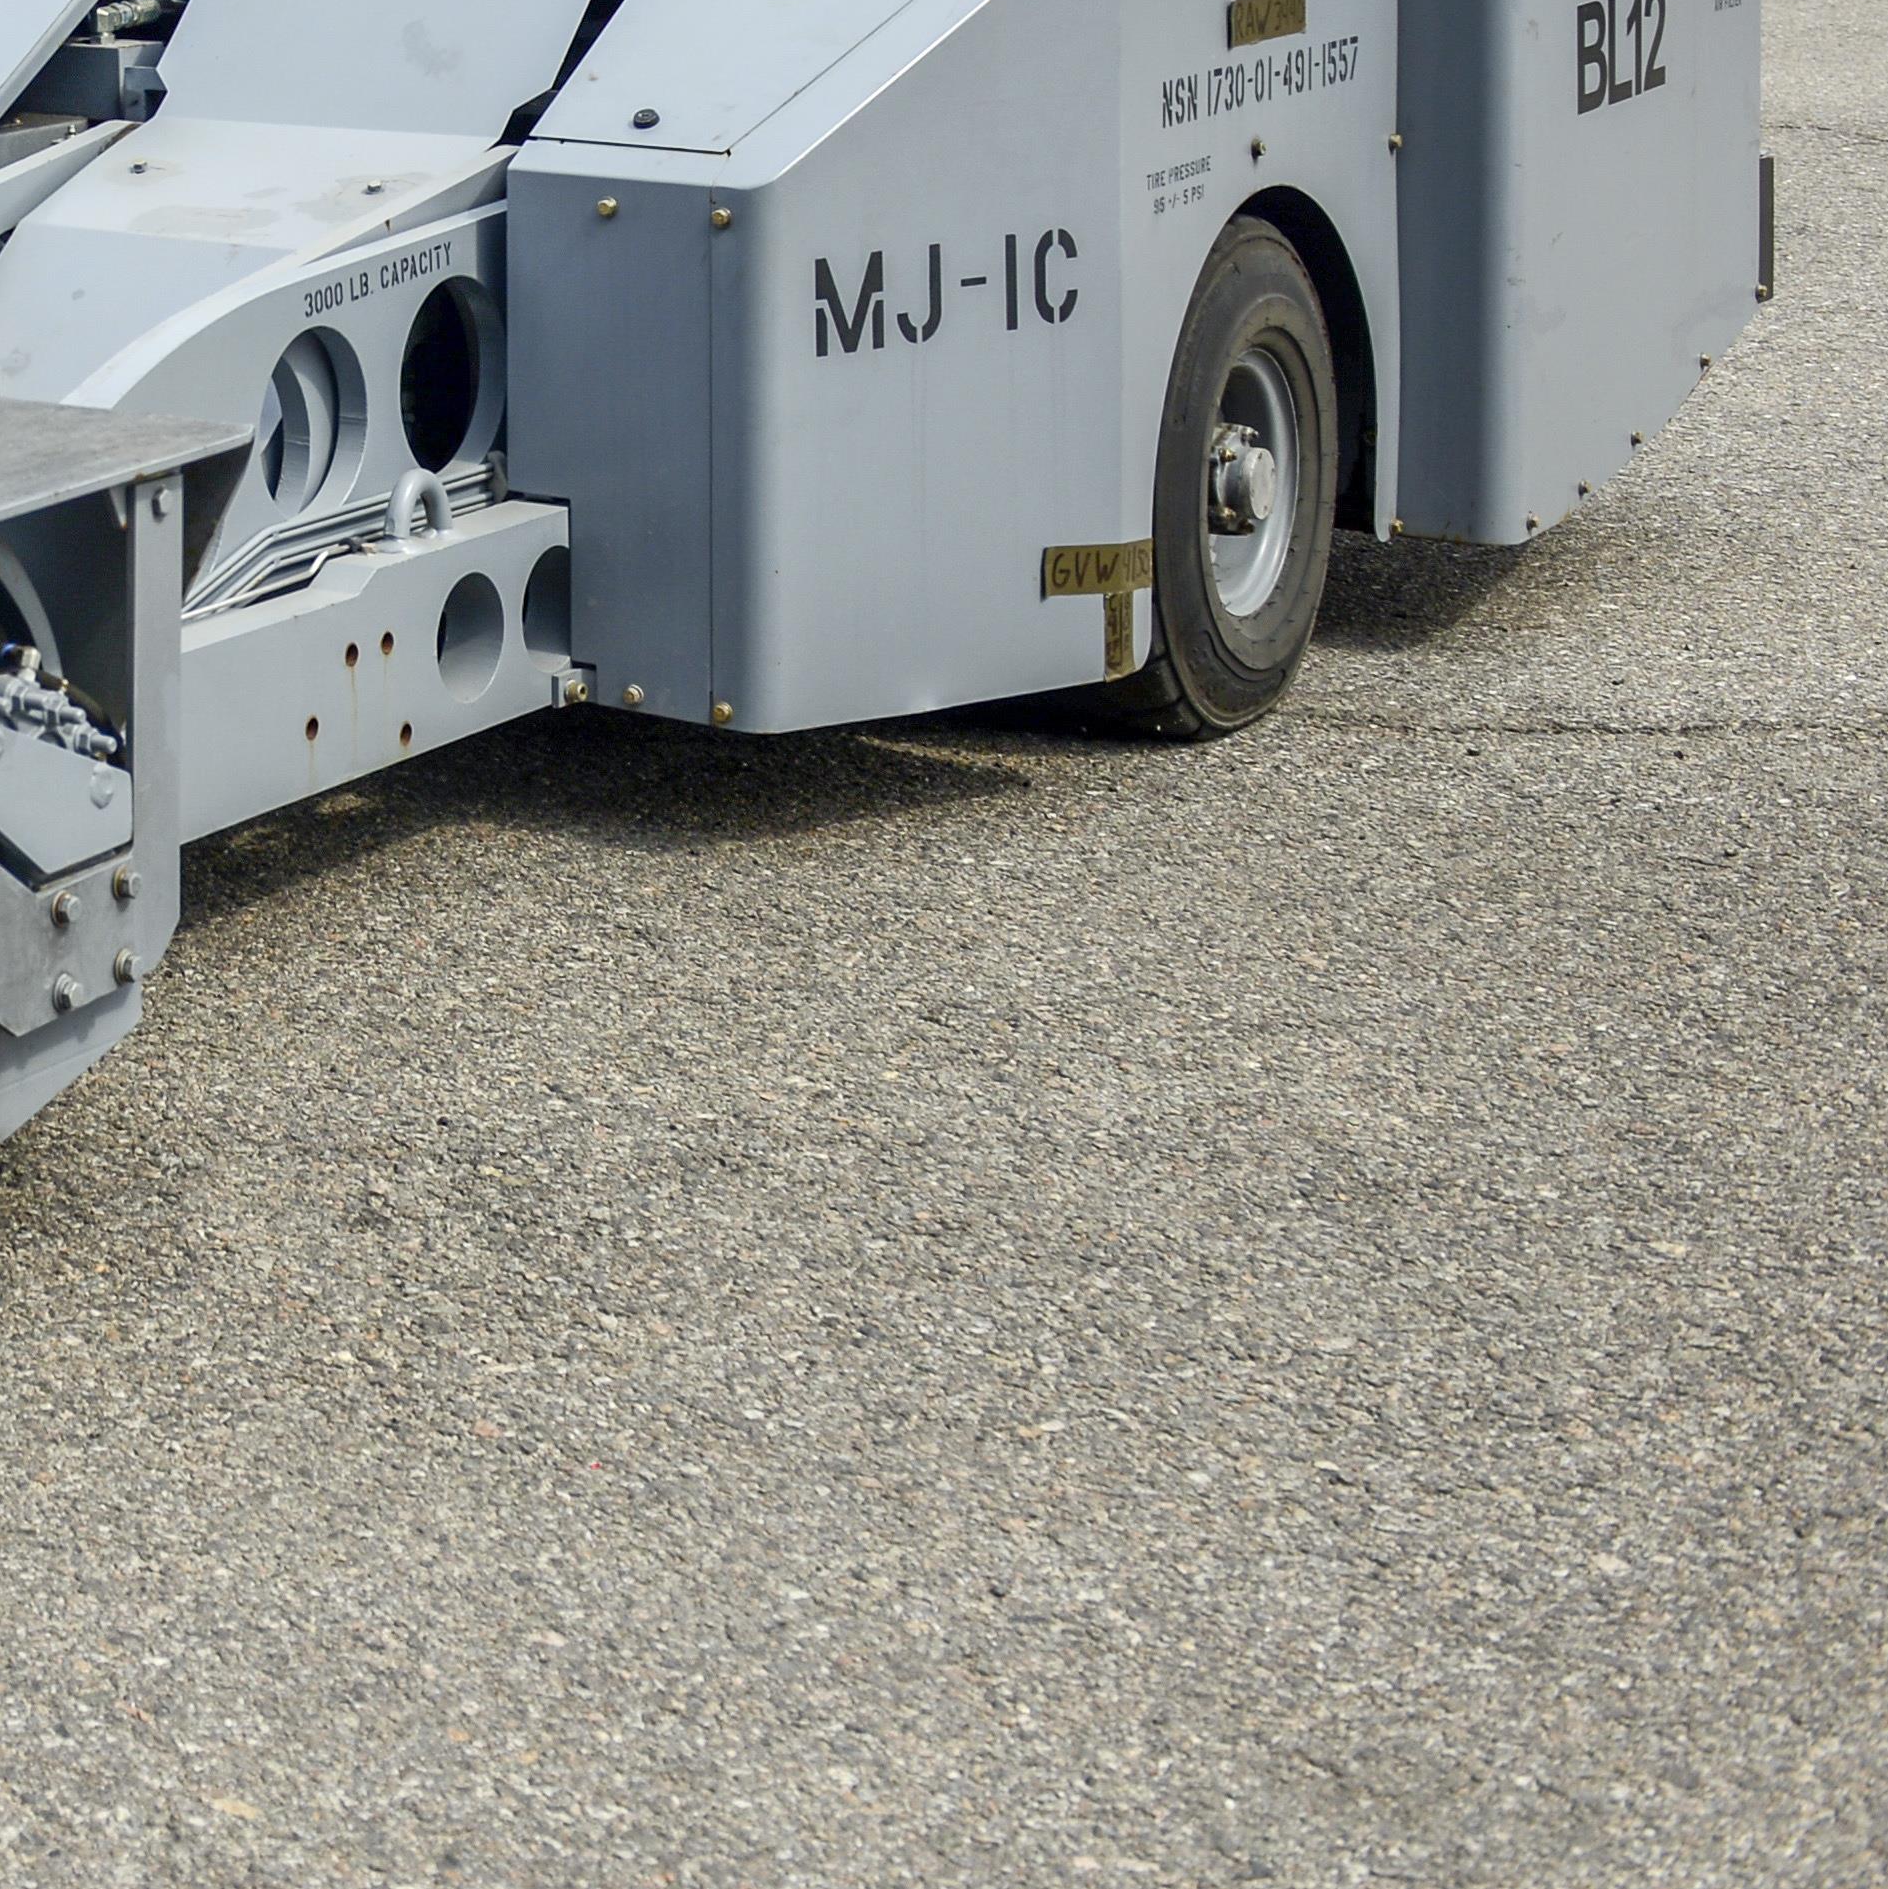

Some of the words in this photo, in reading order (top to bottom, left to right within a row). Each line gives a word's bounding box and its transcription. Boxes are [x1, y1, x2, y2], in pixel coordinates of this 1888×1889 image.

[1162, 73, 1198, 129] NSN
[1207, 35, 1359, 118] 1730-01-491-1557
[1146, 169, 1166, 191] TIRE
[1168, 155, 1212, 184] PRESSURE
[1183, 188, 1190, 206] 5
[1191, 183, 1206, 201] PSI
[304, 281, 344, 318] 3000
[349, 271, 374, 302] LB.
[379, 241, 452, 290] CAPACITY
[1051, 550, 1120, 589] GVW
